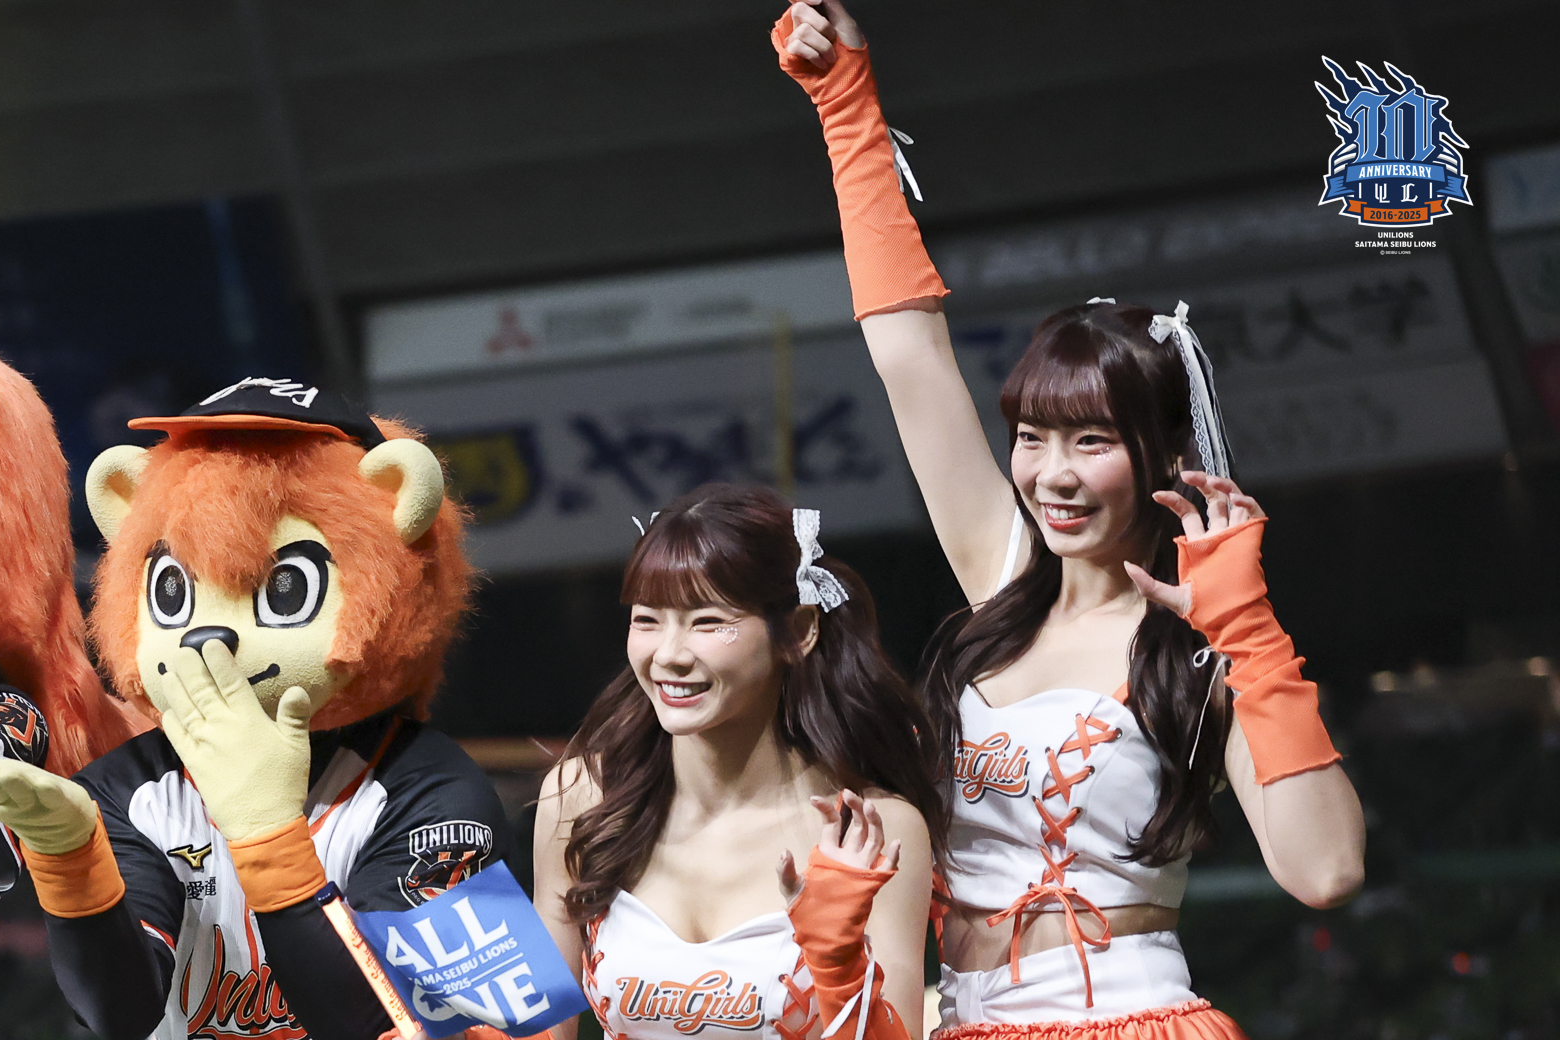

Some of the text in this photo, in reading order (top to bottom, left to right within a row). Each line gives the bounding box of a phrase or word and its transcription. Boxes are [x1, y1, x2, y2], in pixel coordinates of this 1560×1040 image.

[413, 824, 491, 854] UNILIONS
[385, 896, 510, 973] ALL
[444, 960, 479, 980] SEIBU
[478, 937, 519, 964] LIONS
[442, 978, 473, 996] 2025
[615, 969, 765, 1036] UniGirls
